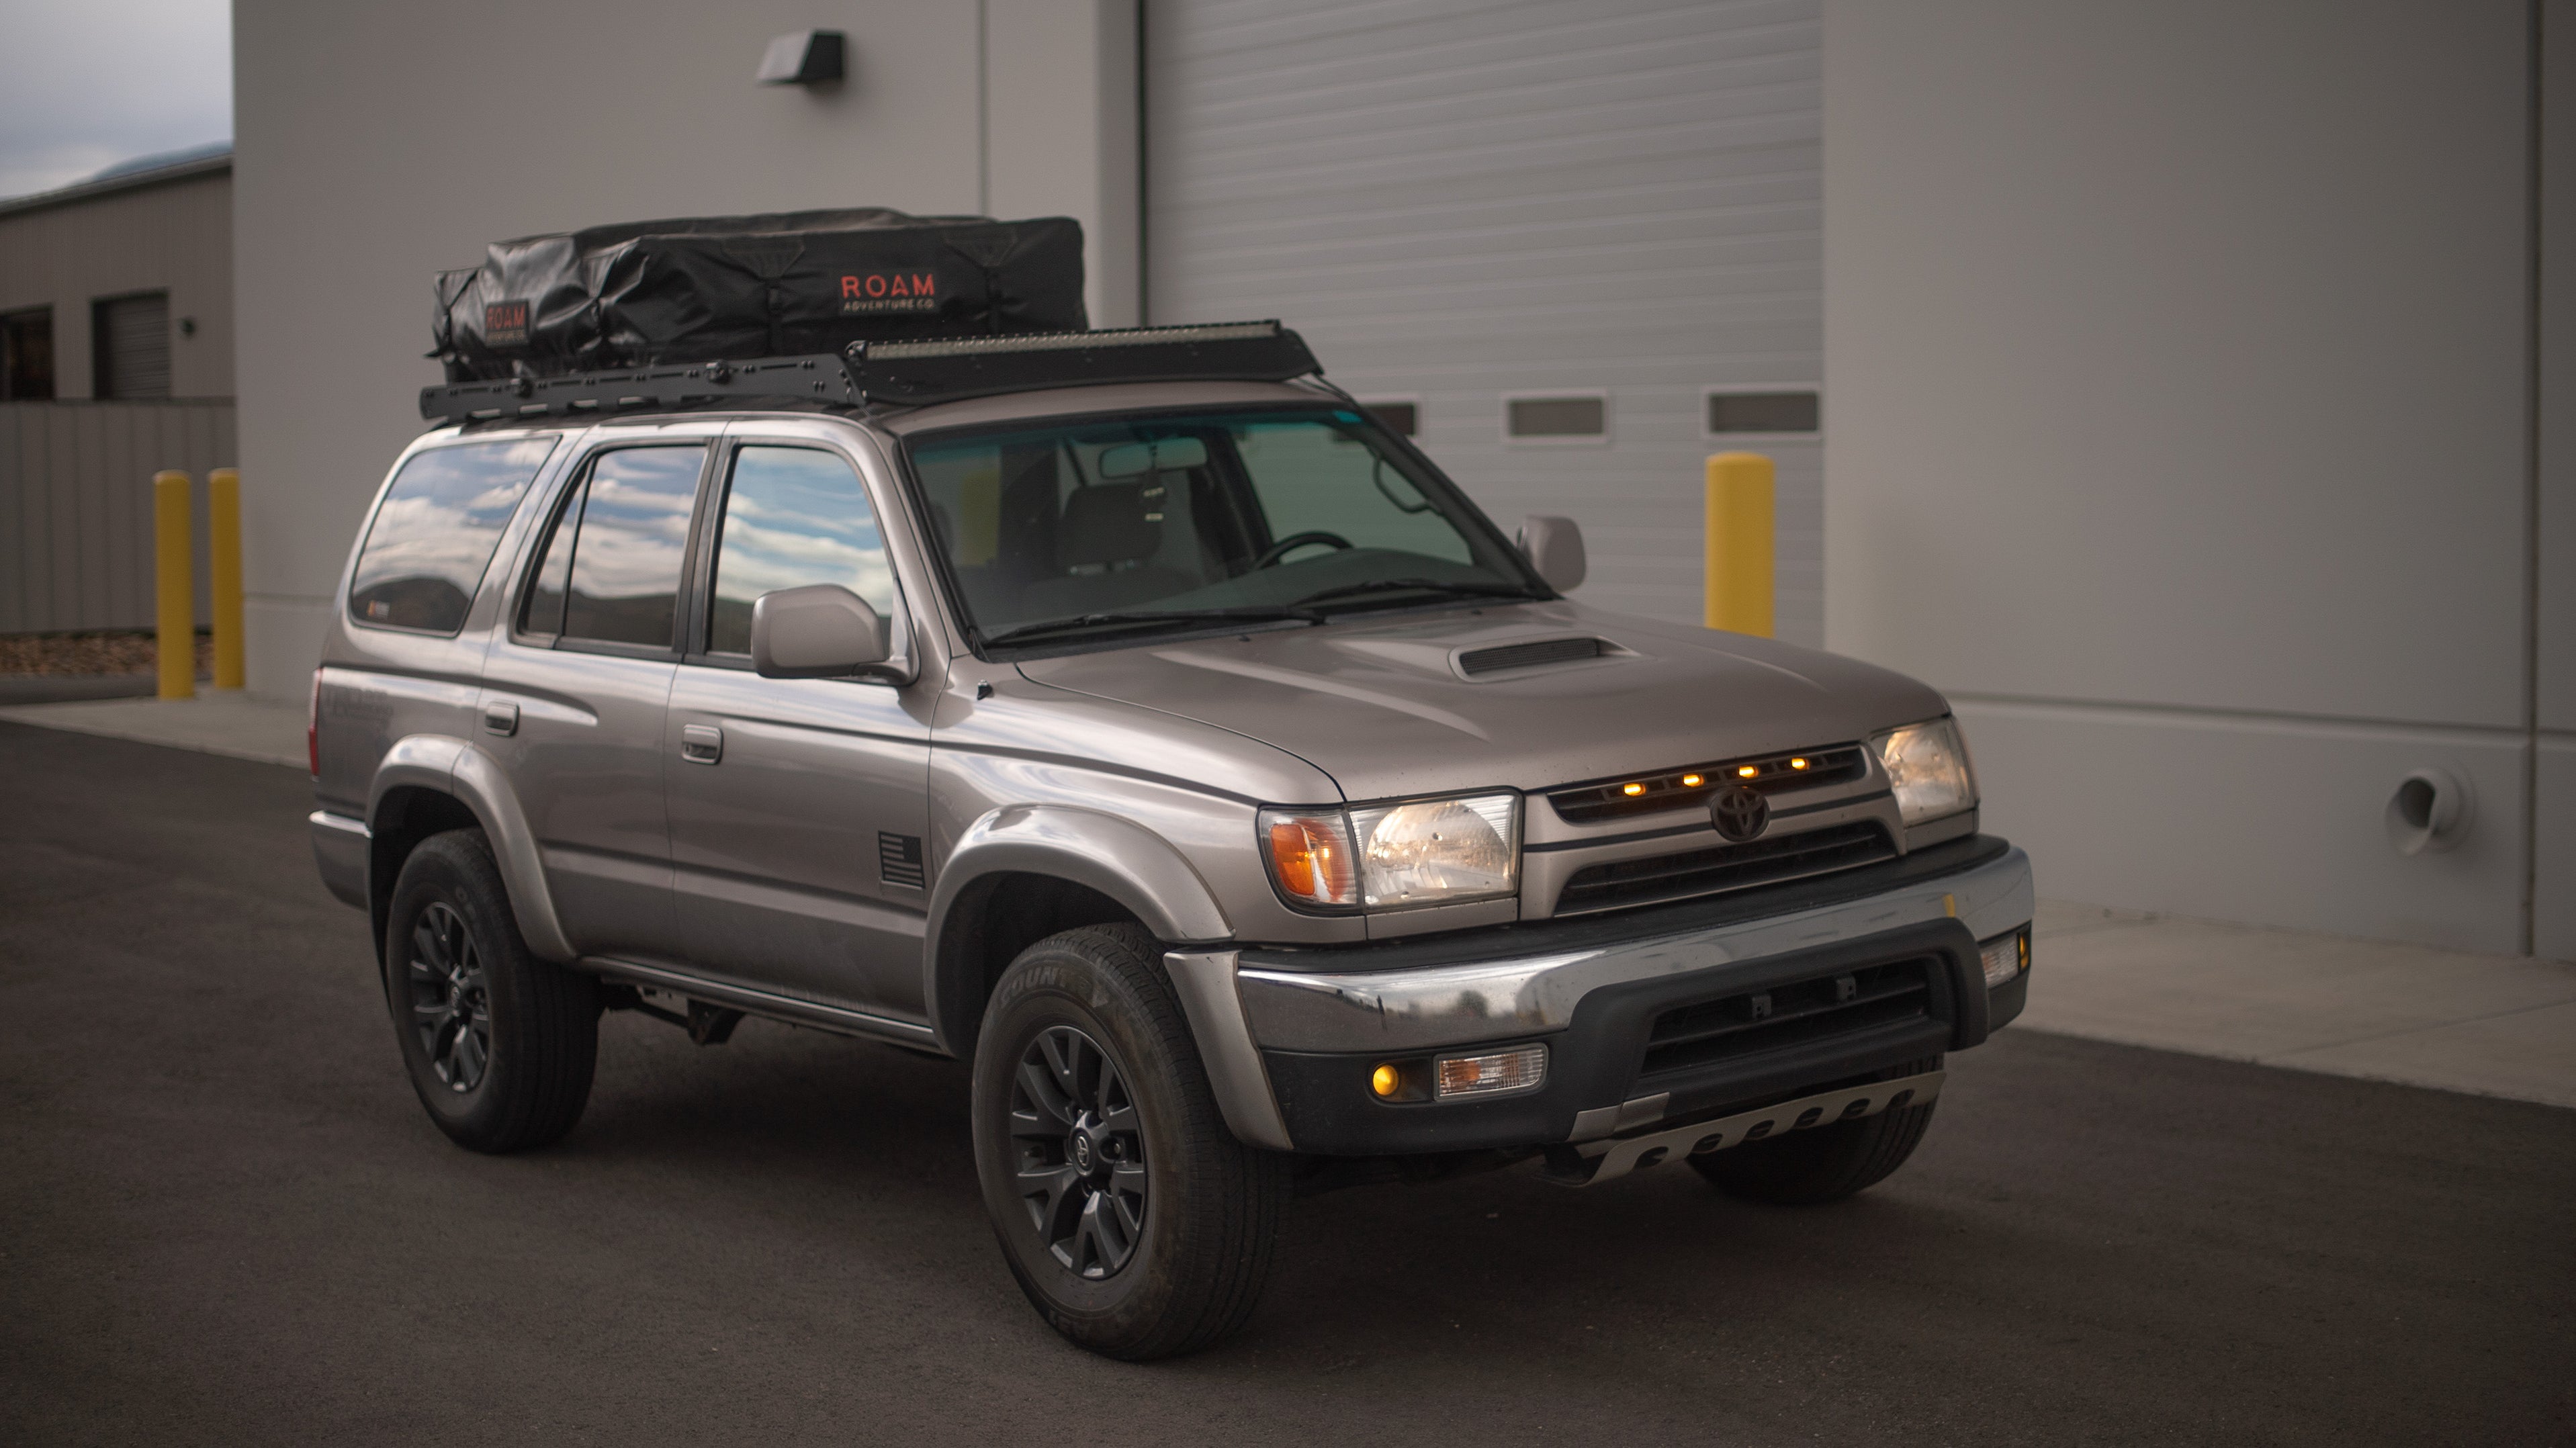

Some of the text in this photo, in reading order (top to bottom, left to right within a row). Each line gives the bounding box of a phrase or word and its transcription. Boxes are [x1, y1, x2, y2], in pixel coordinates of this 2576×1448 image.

[841, 273, 935, 298] ROAM
[486, 304, 525, 329] ROAM
[844, 299, 914, 311] ADVENTURE
